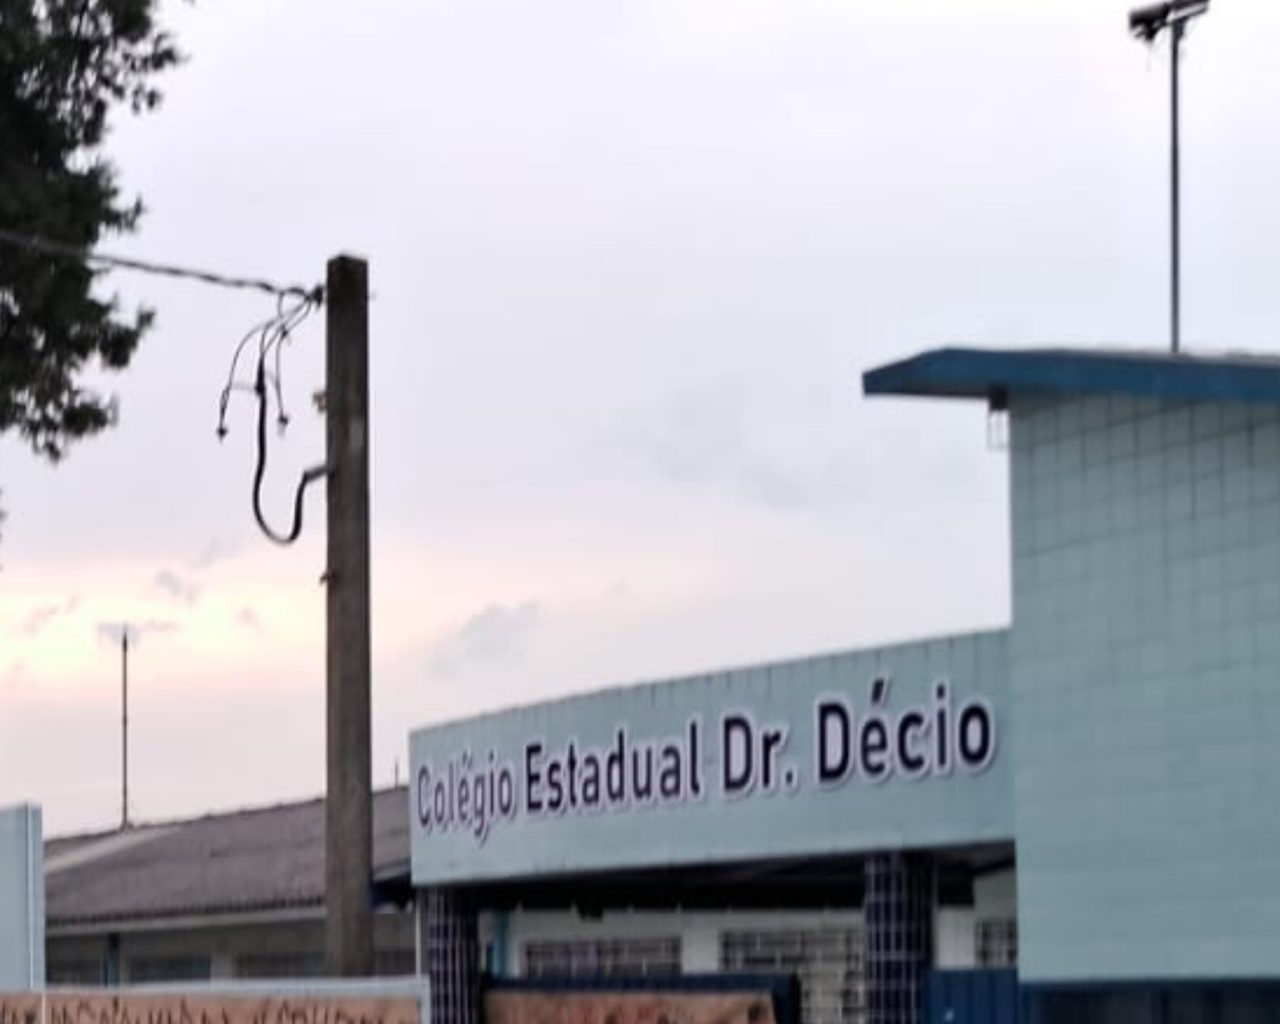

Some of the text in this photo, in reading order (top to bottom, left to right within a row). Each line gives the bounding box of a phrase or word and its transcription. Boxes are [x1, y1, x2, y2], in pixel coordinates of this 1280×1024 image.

[417, 678, 991, 838] Colégio Estadual Dr. Décio
